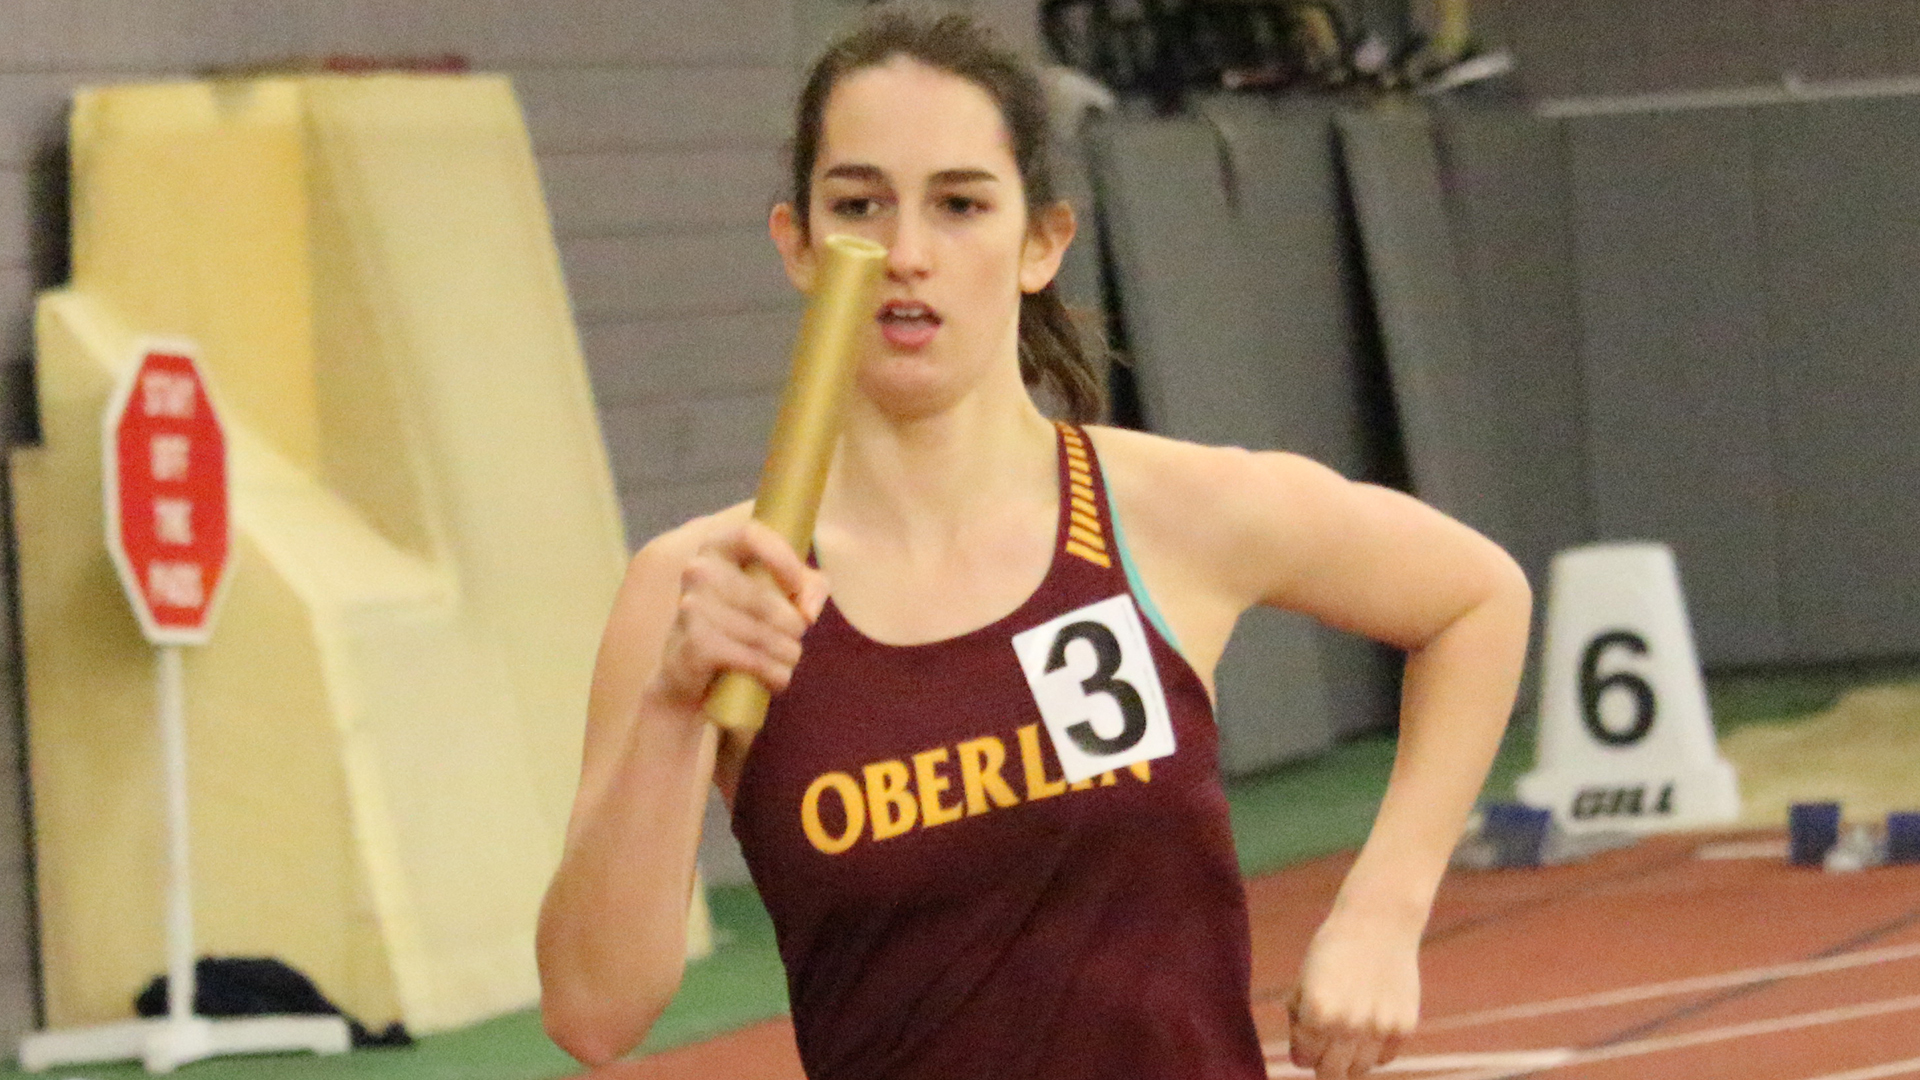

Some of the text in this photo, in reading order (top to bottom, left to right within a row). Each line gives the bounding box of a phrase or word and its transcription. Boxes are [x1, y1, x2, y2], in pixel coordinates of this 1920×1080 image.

[1043, 620, 1147, 757] 3
[1578, 630, 1656, 747] 6
[801, 723, 1151, 854] OBERL
